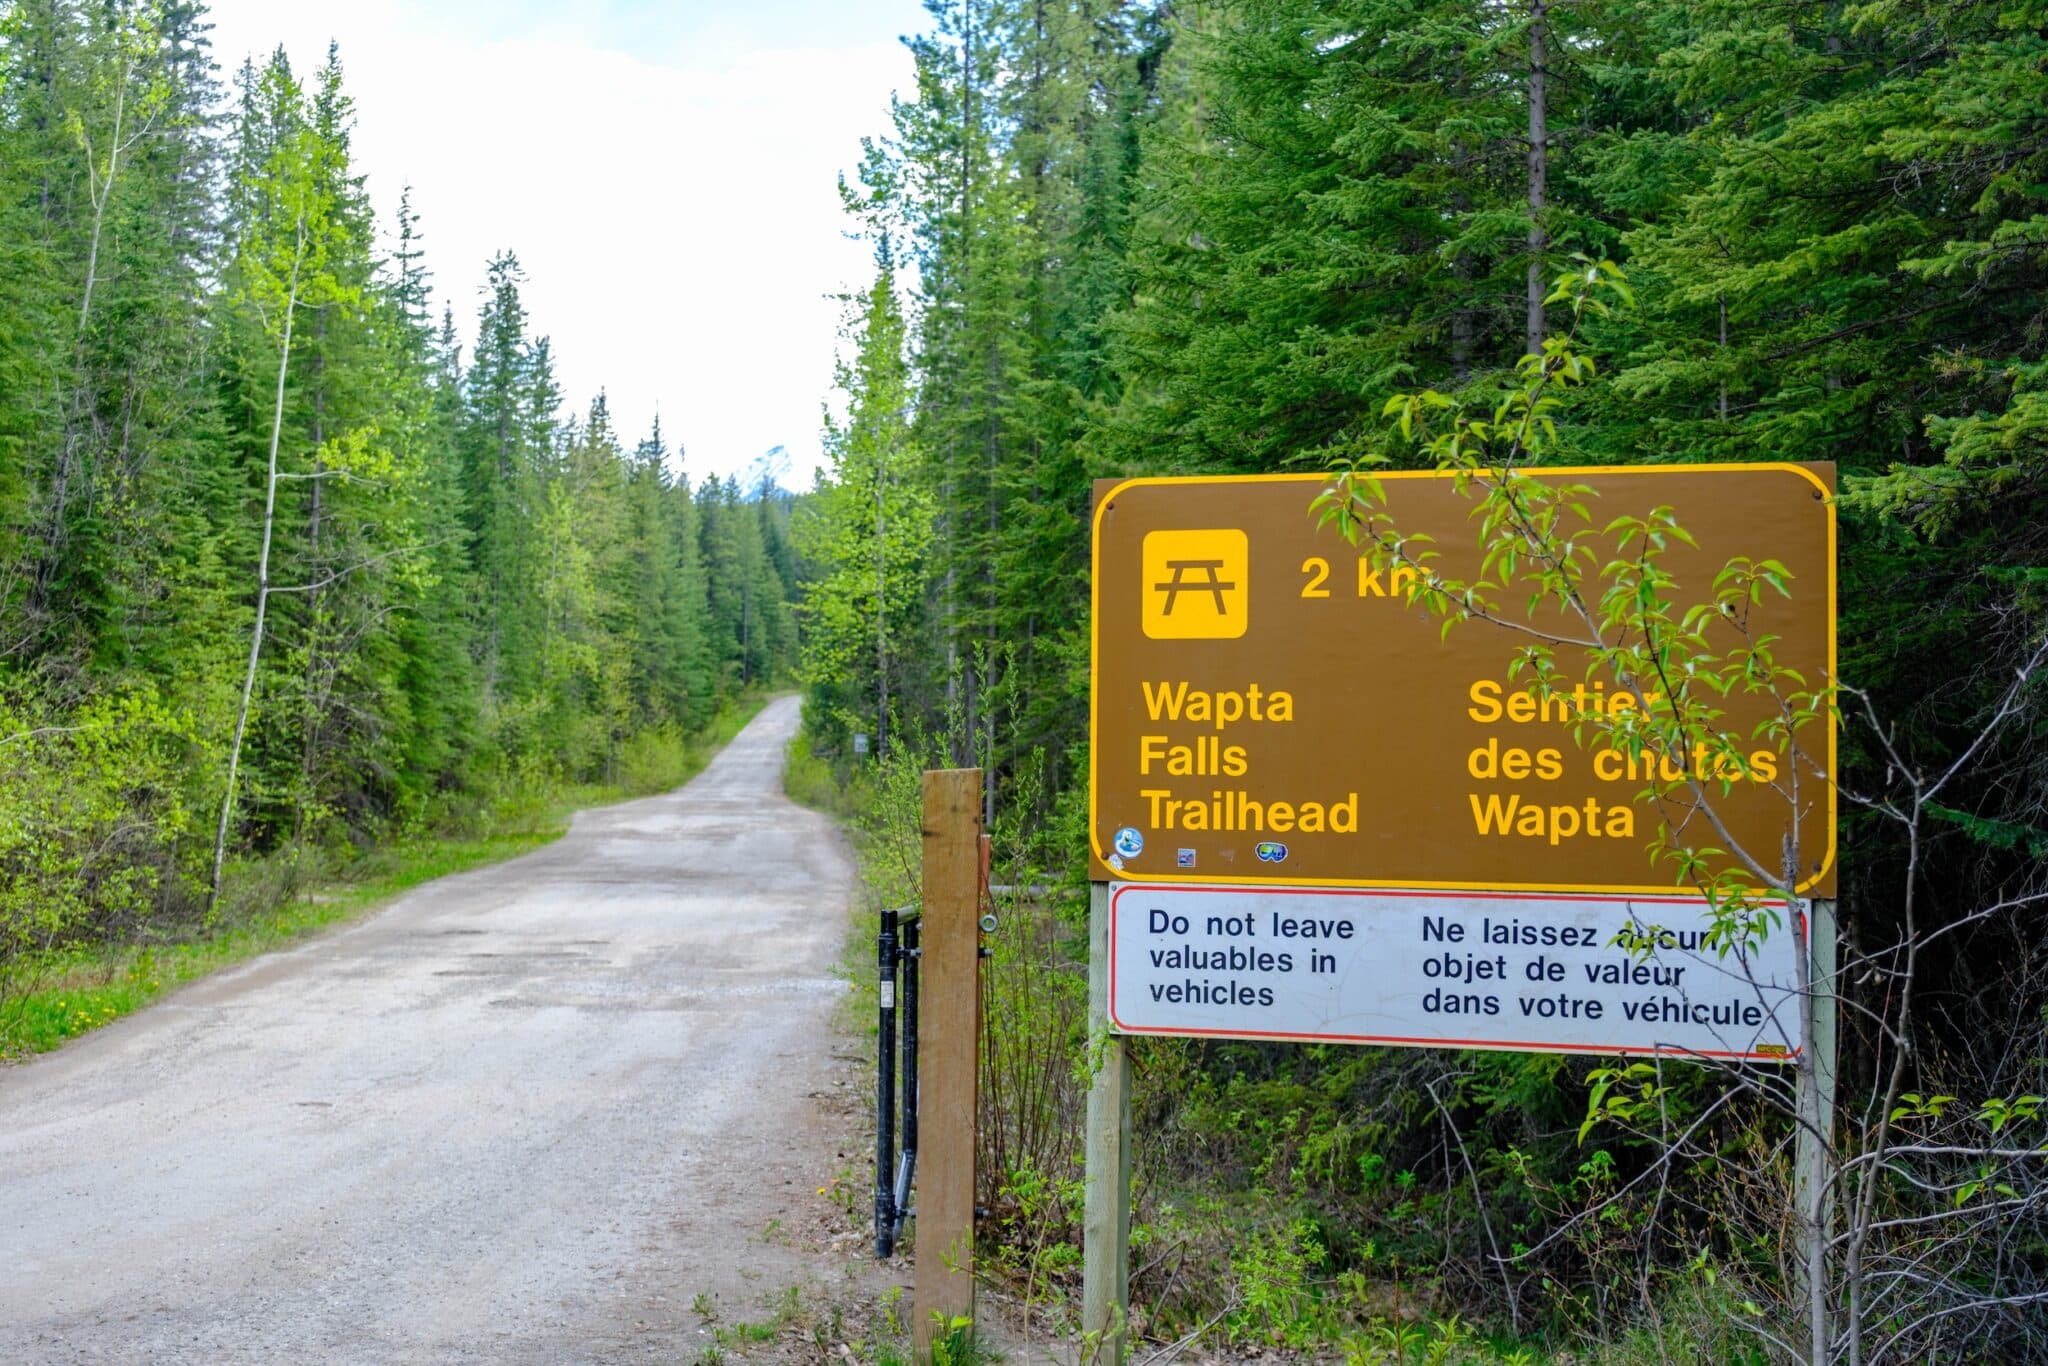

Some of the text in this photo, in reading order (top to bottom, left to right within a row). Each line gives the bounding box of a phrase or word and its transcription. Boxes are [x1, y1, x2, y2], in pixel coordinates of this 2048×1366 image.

[1301, 556, 1330, 598] 2
[1142, 681, 1294, 730] Wapta
[1468, 679, 1661, 724] Sentier
[1140, 735, 1248, 776] Falls
[1468, 737, 1777, 783] des chutes
[1140, 790, 1358, 833] Trailhead
[1469, 794, 1635, 846] Wapta
[1149, 909, 1354, 939] Do not leave
[1422, 916, 1465, 943] Ne
[1483, 918, 1598, 947] laissez
[1150, 945, 1336, 973] valuables in
[1422, 953, 1686, 987] objet de valeur
[1150, 979, 1274, 1006] vehicles
[1422, 988, 1762, 1027] dans votre véhicule
